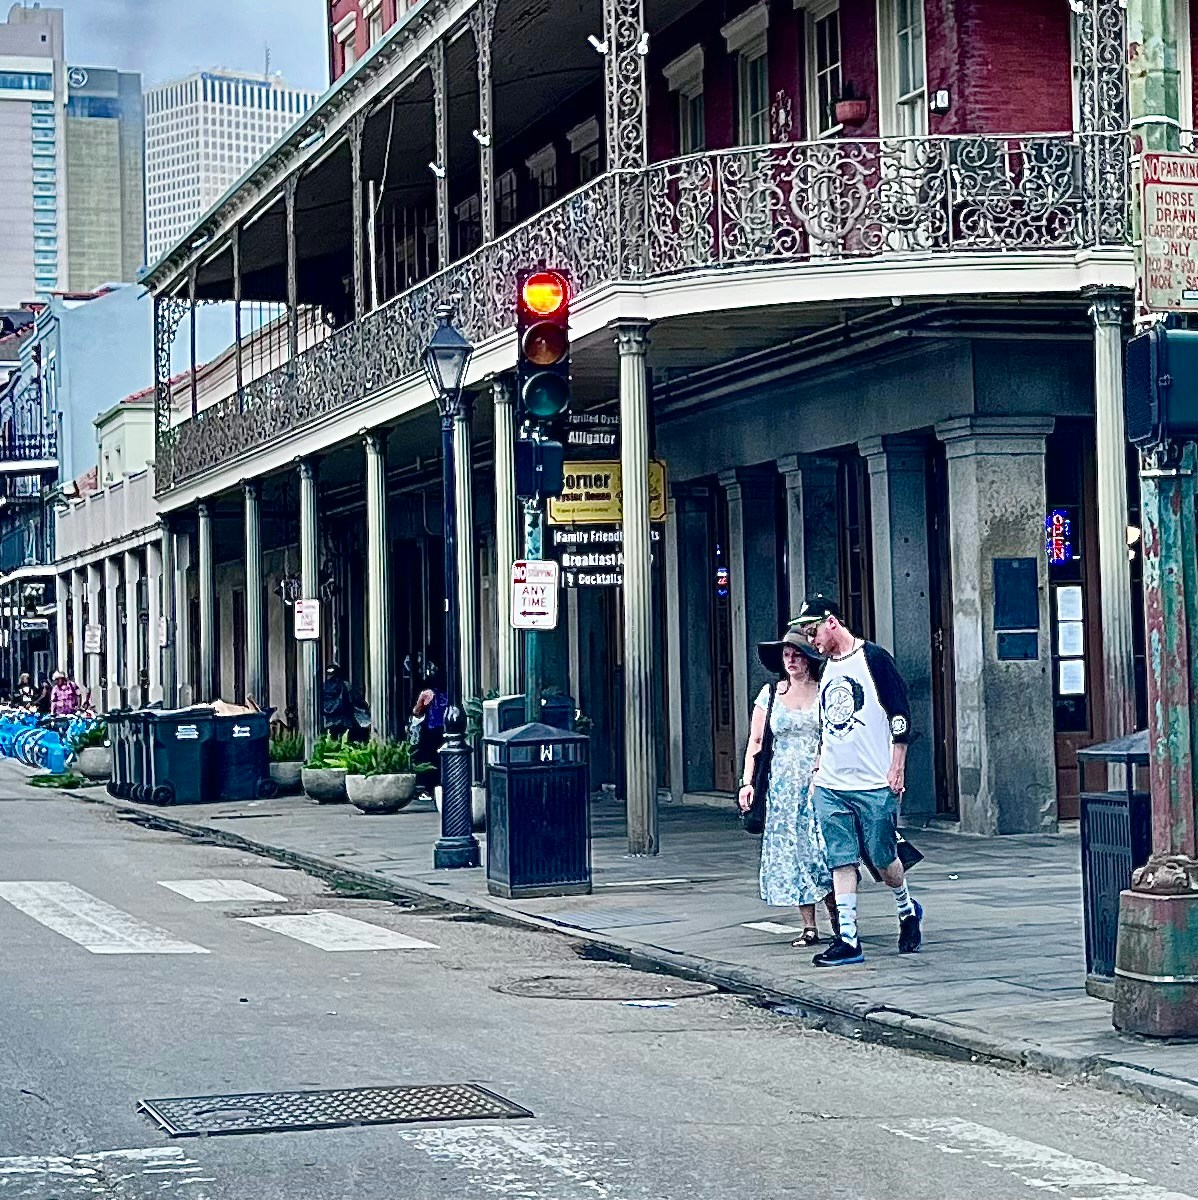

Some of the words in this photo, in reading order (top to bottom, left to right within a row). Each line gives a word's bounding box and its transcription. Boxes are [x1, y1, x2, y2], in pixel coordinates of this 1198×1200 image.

[1144, 159, 1159, 180] NO
[1156, 191, 1194, 207] HORSE
[1156, 208, 1196, 223] DRAWN
[1163, 241, 1190, 257] ONLY
[568, 431, 616, 444] Alligator
[565, 474, 612, 490] orner
[557, 531, 588, 543] Family
[591, 531, 623, 542] Friendl
[1053, 514, 1065, 560] OPEN
[563, 552, 615, 566] Breakfast
[578, 573, 622, 584] Cocktails
[522, 586, 546, 595] ANY
[522, 597, 546, 607] TIME
